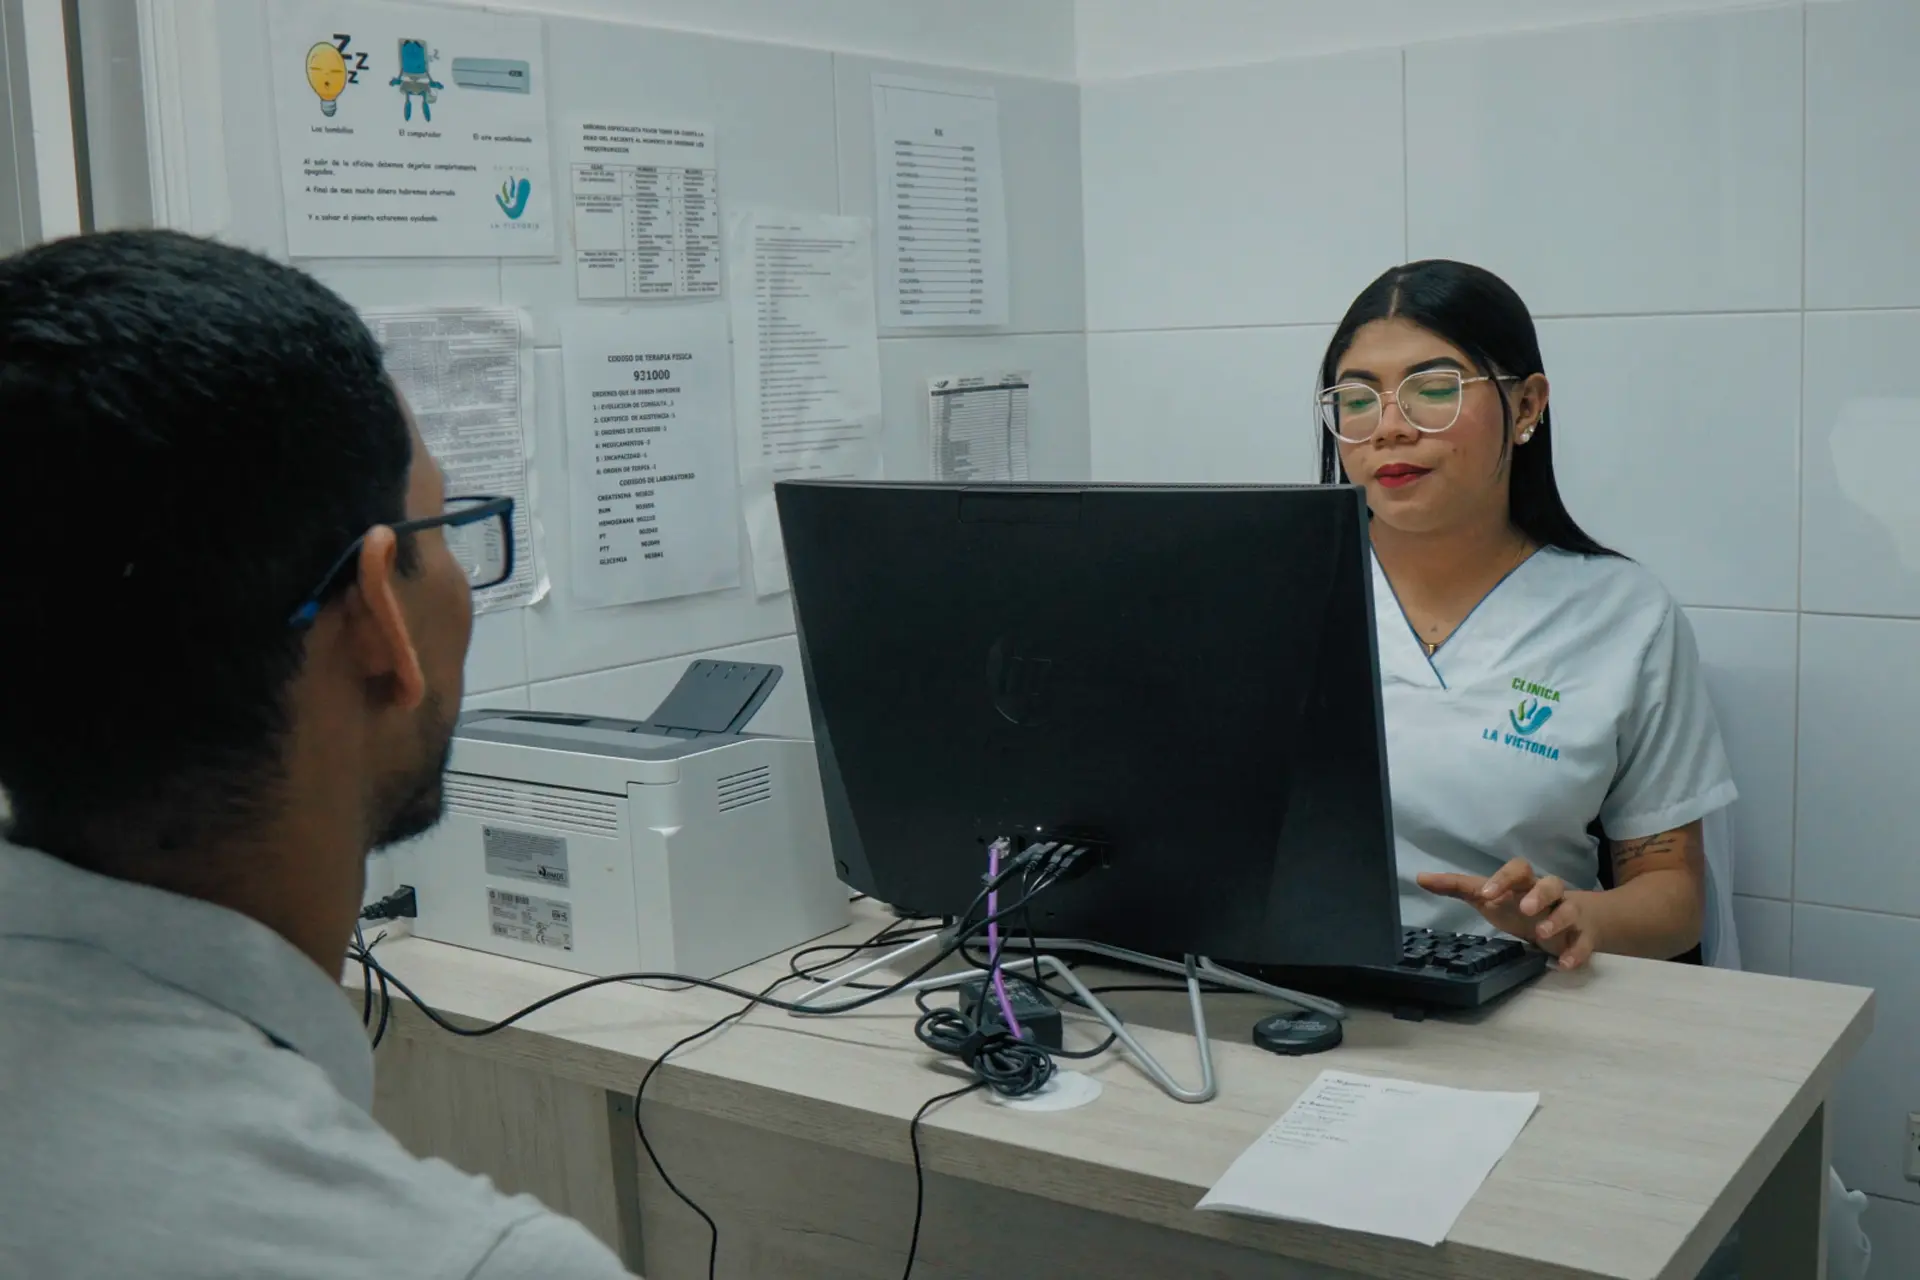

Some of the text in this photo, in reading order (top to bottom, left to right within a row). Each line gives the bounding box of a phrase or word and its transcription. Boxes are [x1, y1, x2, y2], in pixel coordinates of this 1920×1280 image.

[377, 187, 397, 195] dinero
[635, 354, 643, 362] DE
[645, 353, 671, 361] TERAPIA
[633, 369, 671, 382] 931000
[656, 472, 695, 483] LABORATORIO
[1511, 677, 1560, 702] CLINICA
[1482, 728, 1560, 761] LA VICTORIA
